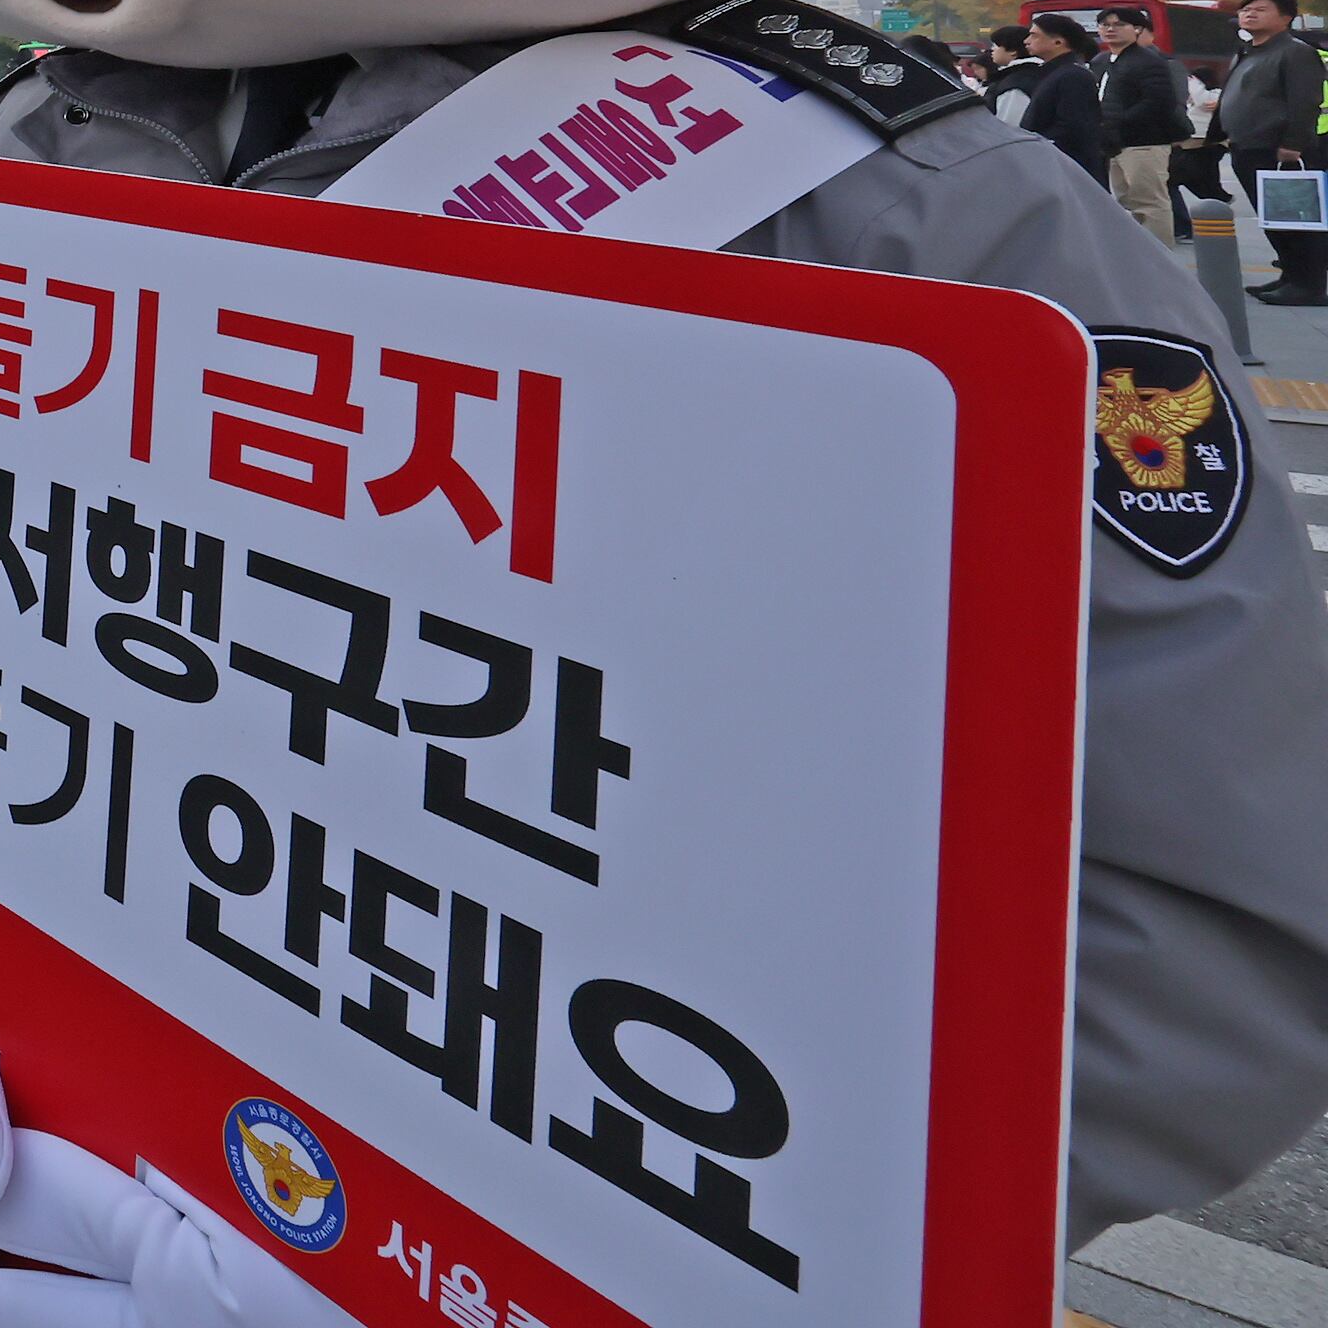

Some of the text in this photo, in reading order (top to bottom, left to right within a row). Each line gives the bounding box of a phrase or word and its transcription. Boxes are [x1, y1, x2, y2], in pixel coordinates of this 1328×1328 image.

[200, 309, 564, 584] 금지
[1118, 490, 1213, 514] POLICE
[176, 773, 801, 1293] 안돼요
[249, 1103, 323, 1160] 서울종로경찰서
[230, 1144, 338, 1243] SEOUL JONGNO POLICE STATION
